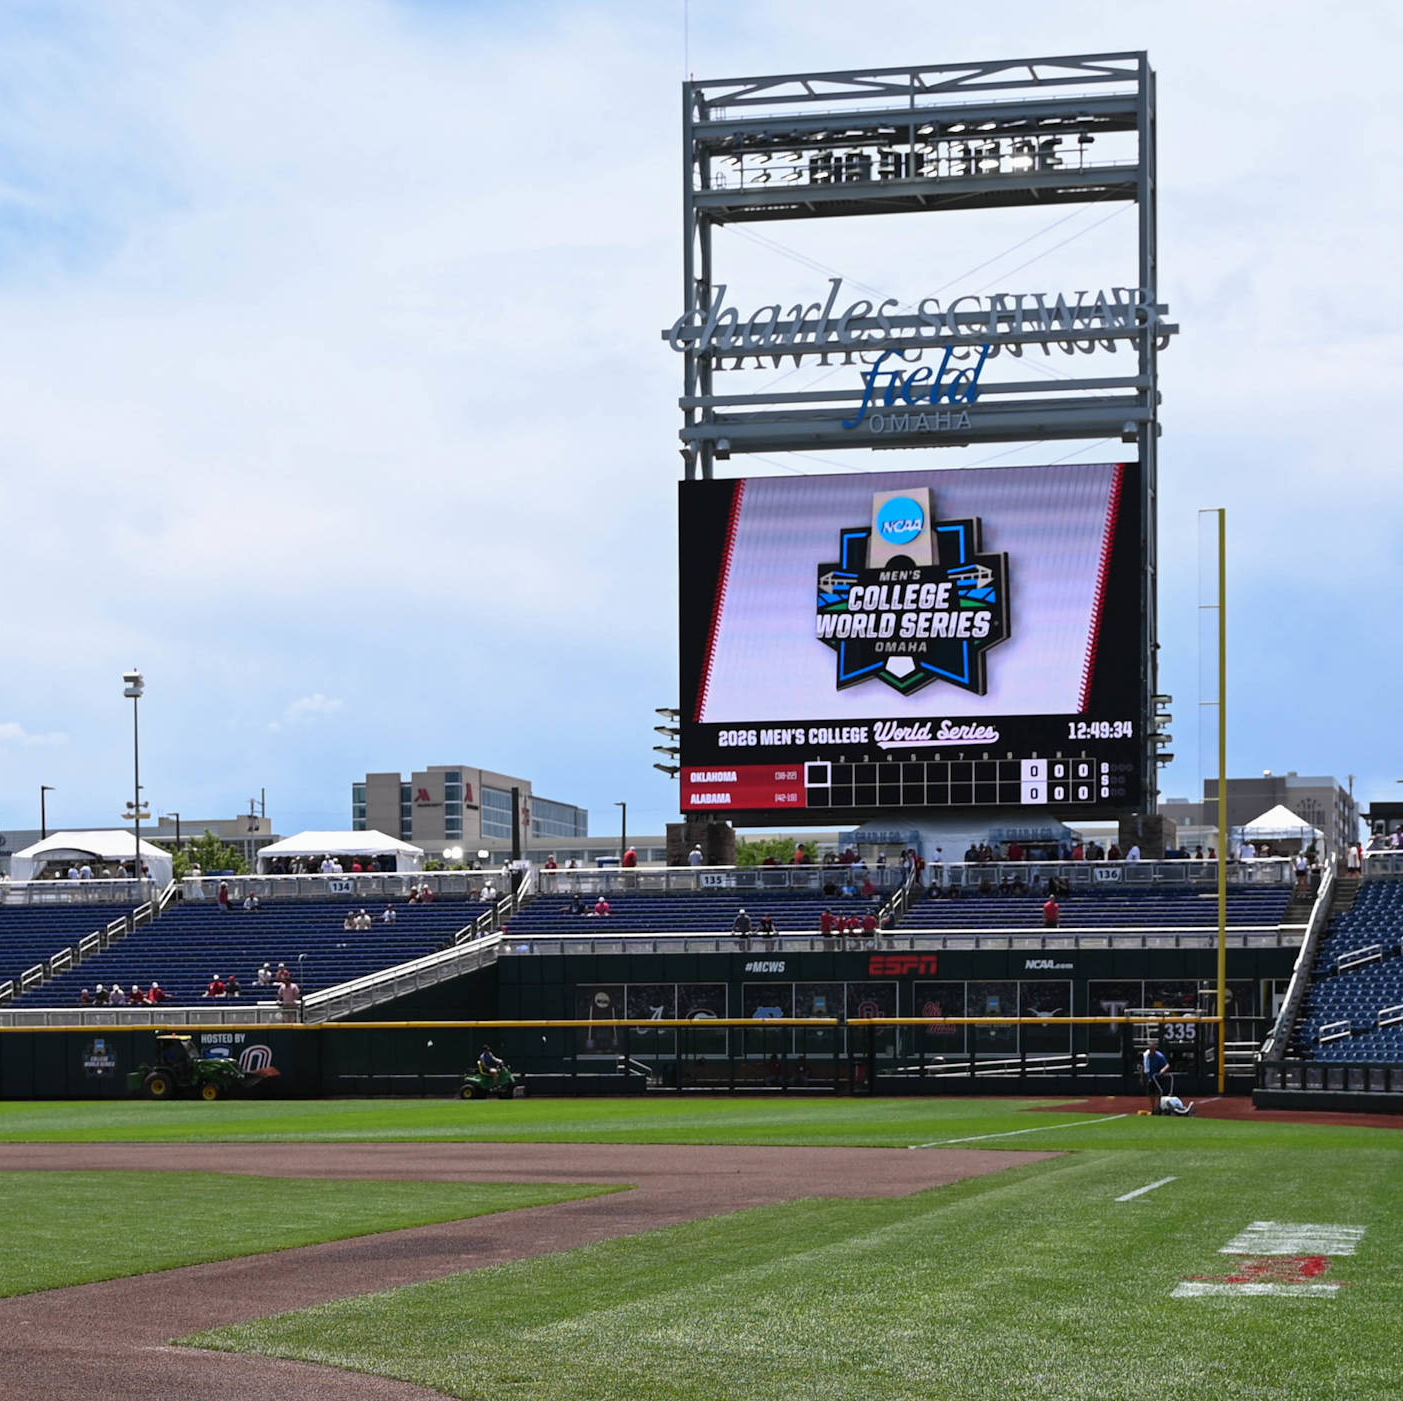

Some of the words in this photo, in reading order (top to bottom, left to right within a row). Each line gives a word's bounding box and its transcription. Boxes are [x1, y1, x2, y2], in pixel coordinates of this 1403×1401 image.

[918, 287, 1159, 341] SCHWAB
[843, 344, 992, 429] field
[868, 410, 973, 434] OMAHA
[882, 519, 922, 533] NCAA
[879, 569, 921, 582] MEN'S
[848, 582, 953, 612] COLLEGE
[816, 612, 896, 639] WORLD
[899, 611, 992, 639] SERIES
[875, 641, 928, 653] OMAHA
[718, 729, 757, 747] 2026
[760, 728, 806, 746] MEN'S
[808, 726, 869, 744] COLLEGE
[873, 721, 932, 744] World
[936, 719, 999, 741] Series
[1068, 721, 1133, 740] 12:49:34
[690, 771, 737, 783] OKLAHOMA
[1030, 765, 1038, 777] 0
[1054, 764, 1064, 777] 0
[1078, 763, 1088, 777] 0
[690, 793, 731, 804] ALABAMA
[1030, 788, 1038, 800] 0
[1054, 786, 1064, 799] 0
[1078, 785, 1088, 799] 0
[705, 876, 722, 884] 135
[1098, 870, 1117, 878] 136
[333, 883, 349, 891] 134
[745, 961, 785, 973] #MCWS
[869, 955, 937, 975] ESPN
[1025, 959, 1073, 970] NCAA.com
[201, 1034, 233, 1044] HOSTED
[235, 1033, 246, 1044] BY
[1164, 1023, 1196, 1039] 335
